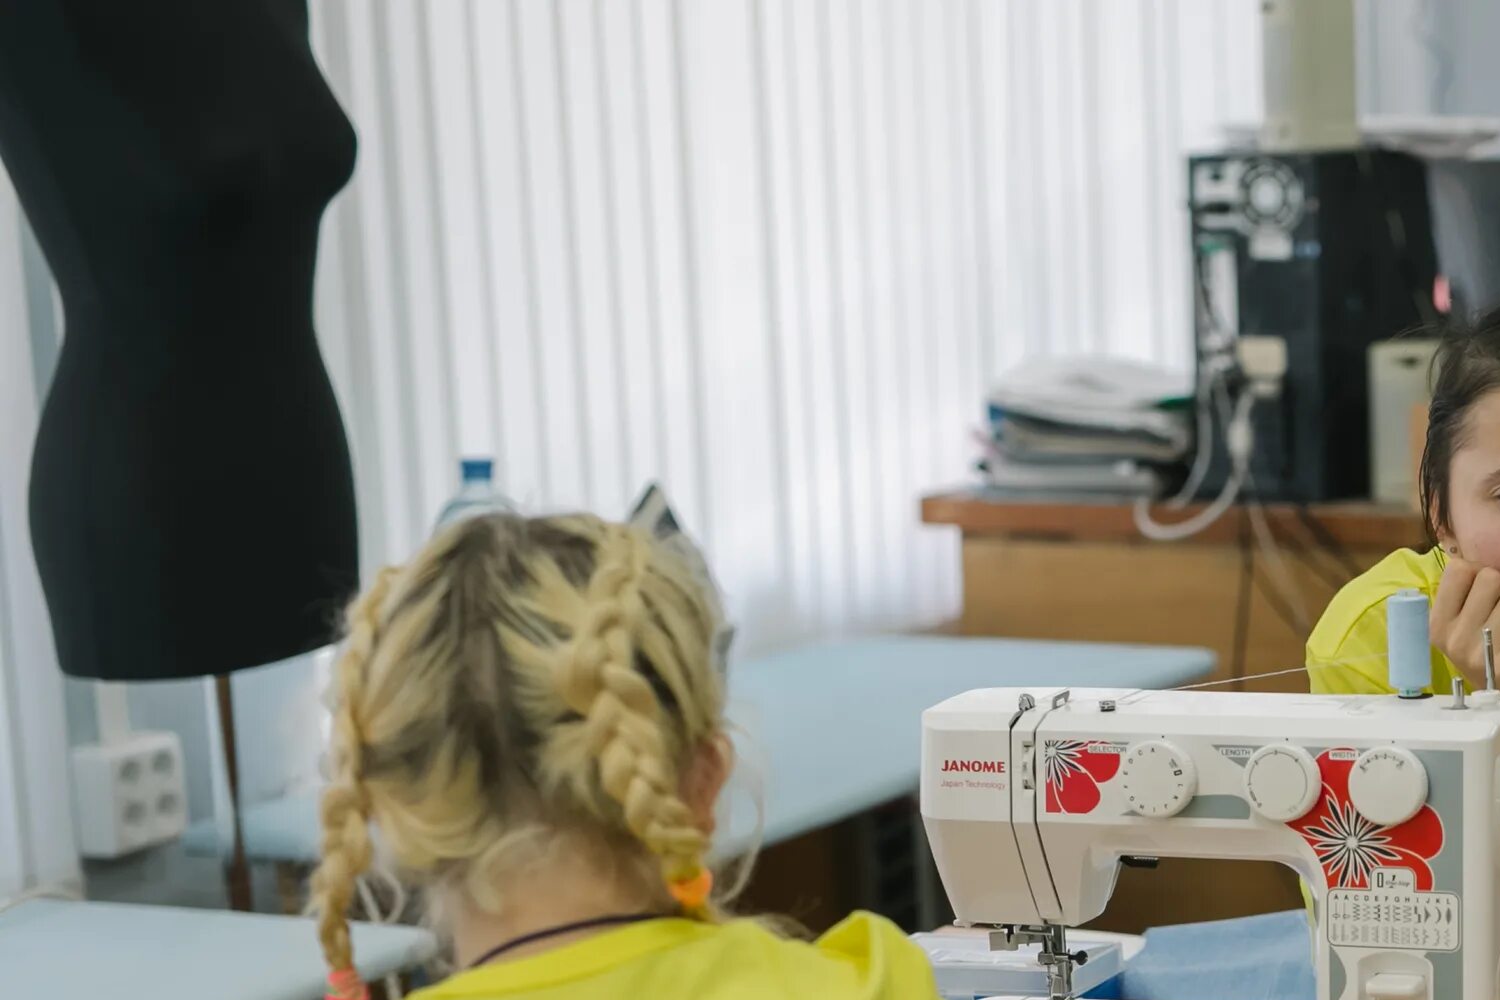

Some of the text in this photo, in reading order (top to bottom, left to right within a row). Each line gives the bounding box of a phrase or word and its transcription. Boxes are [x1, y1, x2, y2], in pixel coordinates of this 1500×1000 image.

[1220, 749, 1251, 757] LENGTH
[1330, 752, 1357, 760] WIDTH
[941, 759, 1006, 773] JANOME
[940, 779, 1006, 791] Japan Technology
